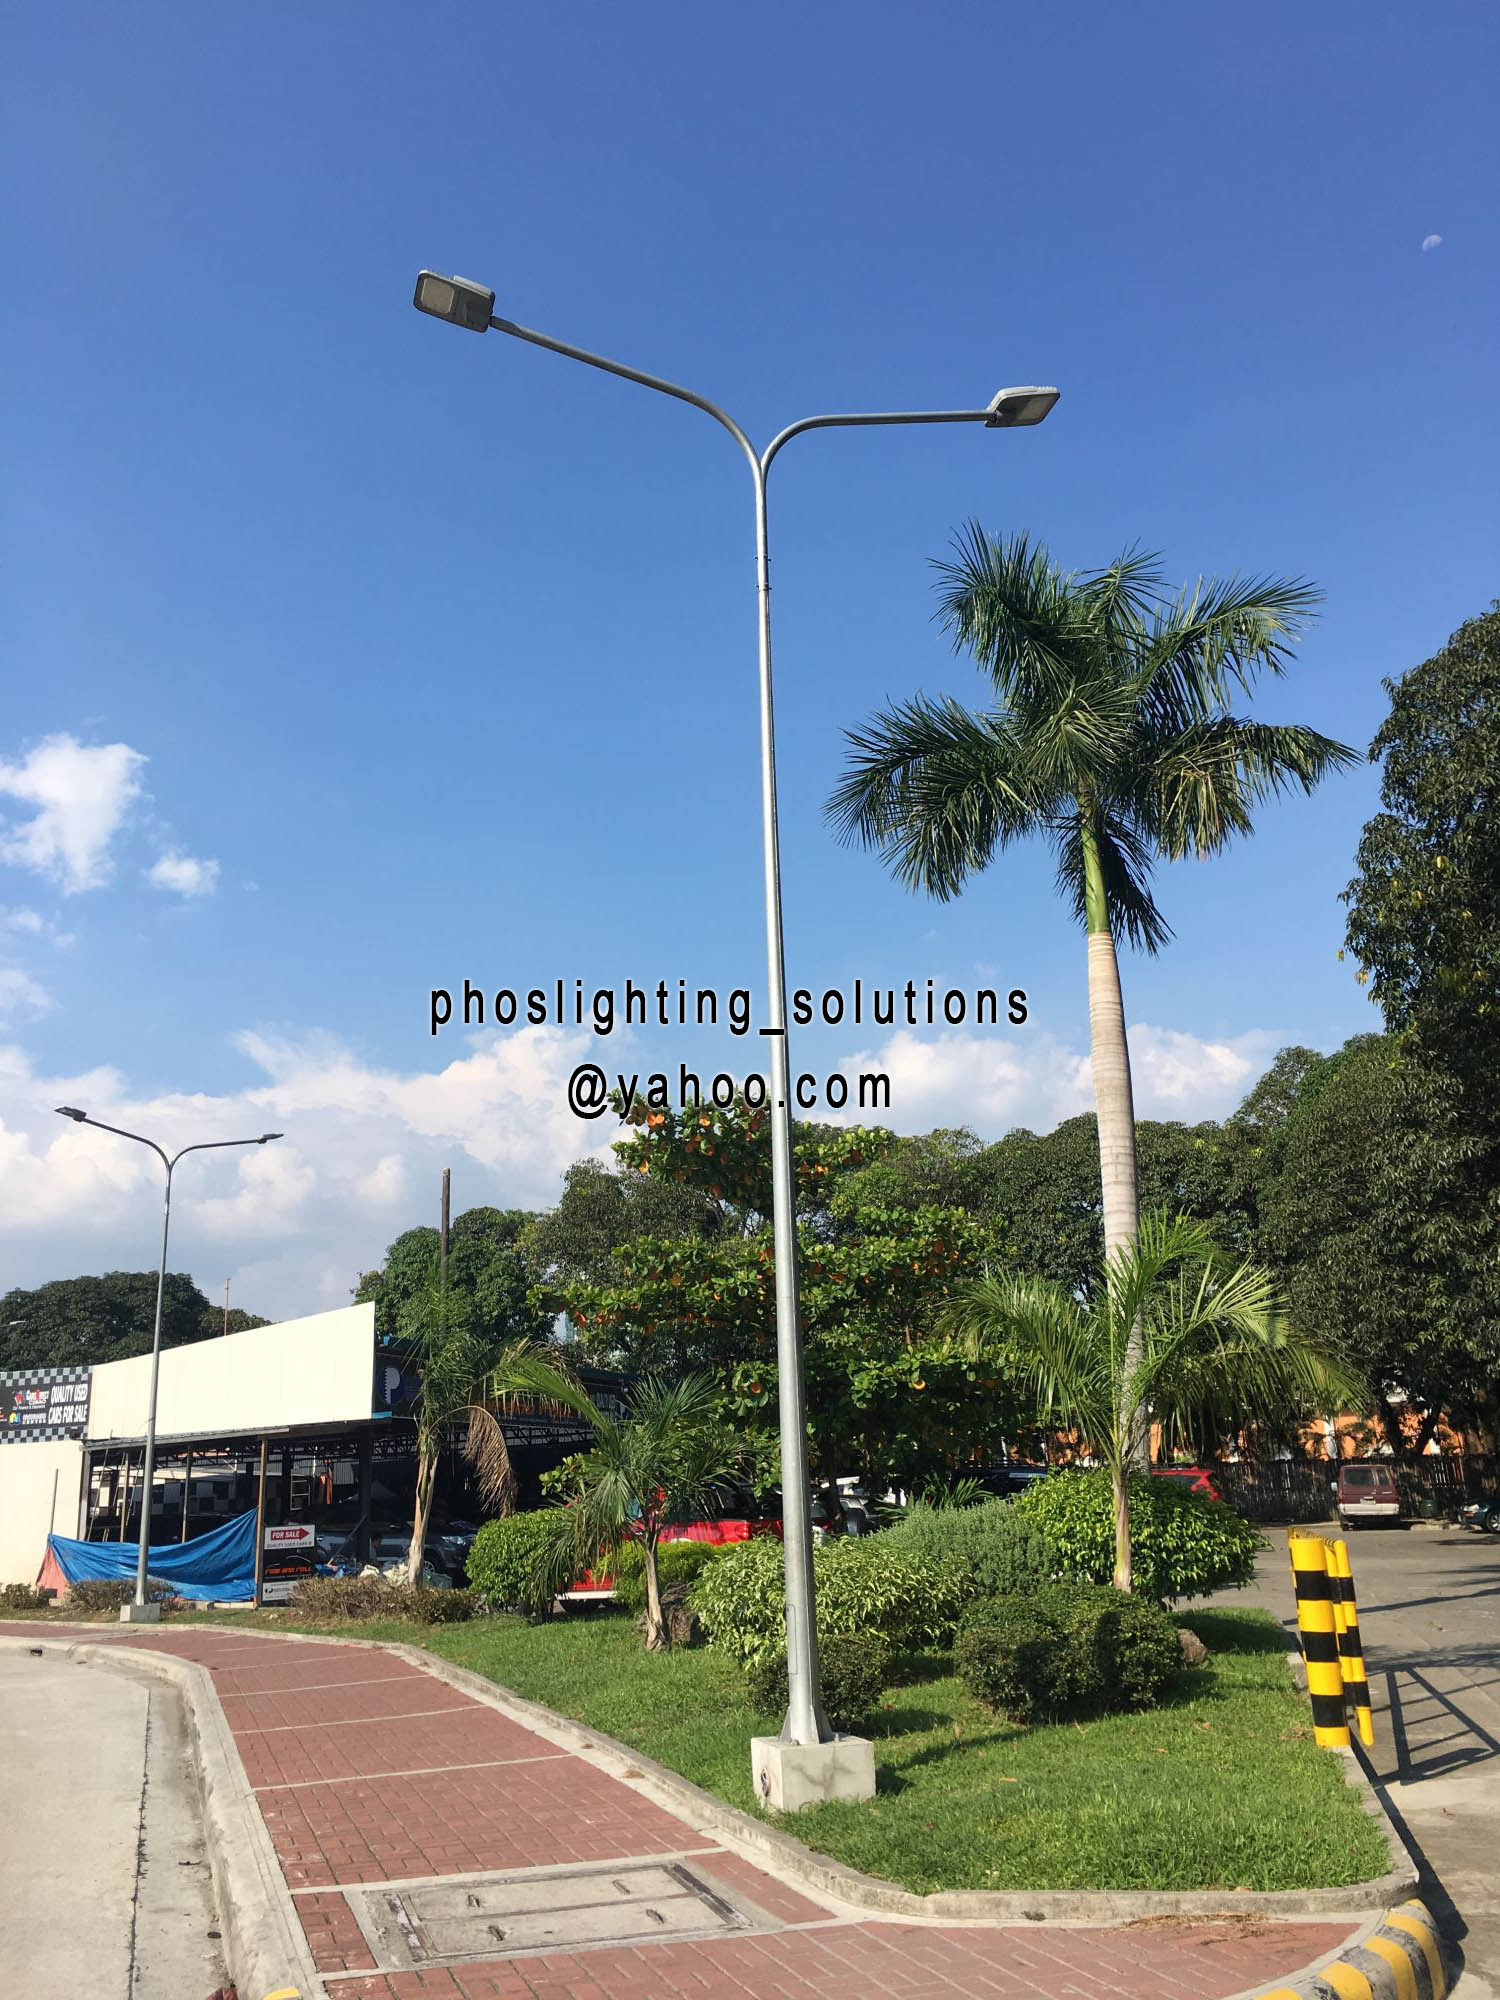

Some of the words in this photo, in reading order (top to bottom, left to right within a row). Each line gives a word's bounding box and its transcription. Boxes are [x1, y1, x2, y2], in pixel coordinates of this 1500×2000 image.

[51, 1385, 74, 1405] QUALITY
[74, 1384, 88, 1401] USED
[48, 1406, 63, 1424] CARS
[63, 1405, 74, 1423] FOR
[74, 1404, 88, 1422] SALE
[272, 1531, 284, 1539] FOR
[285, 1530, 300, 1538] SALE
